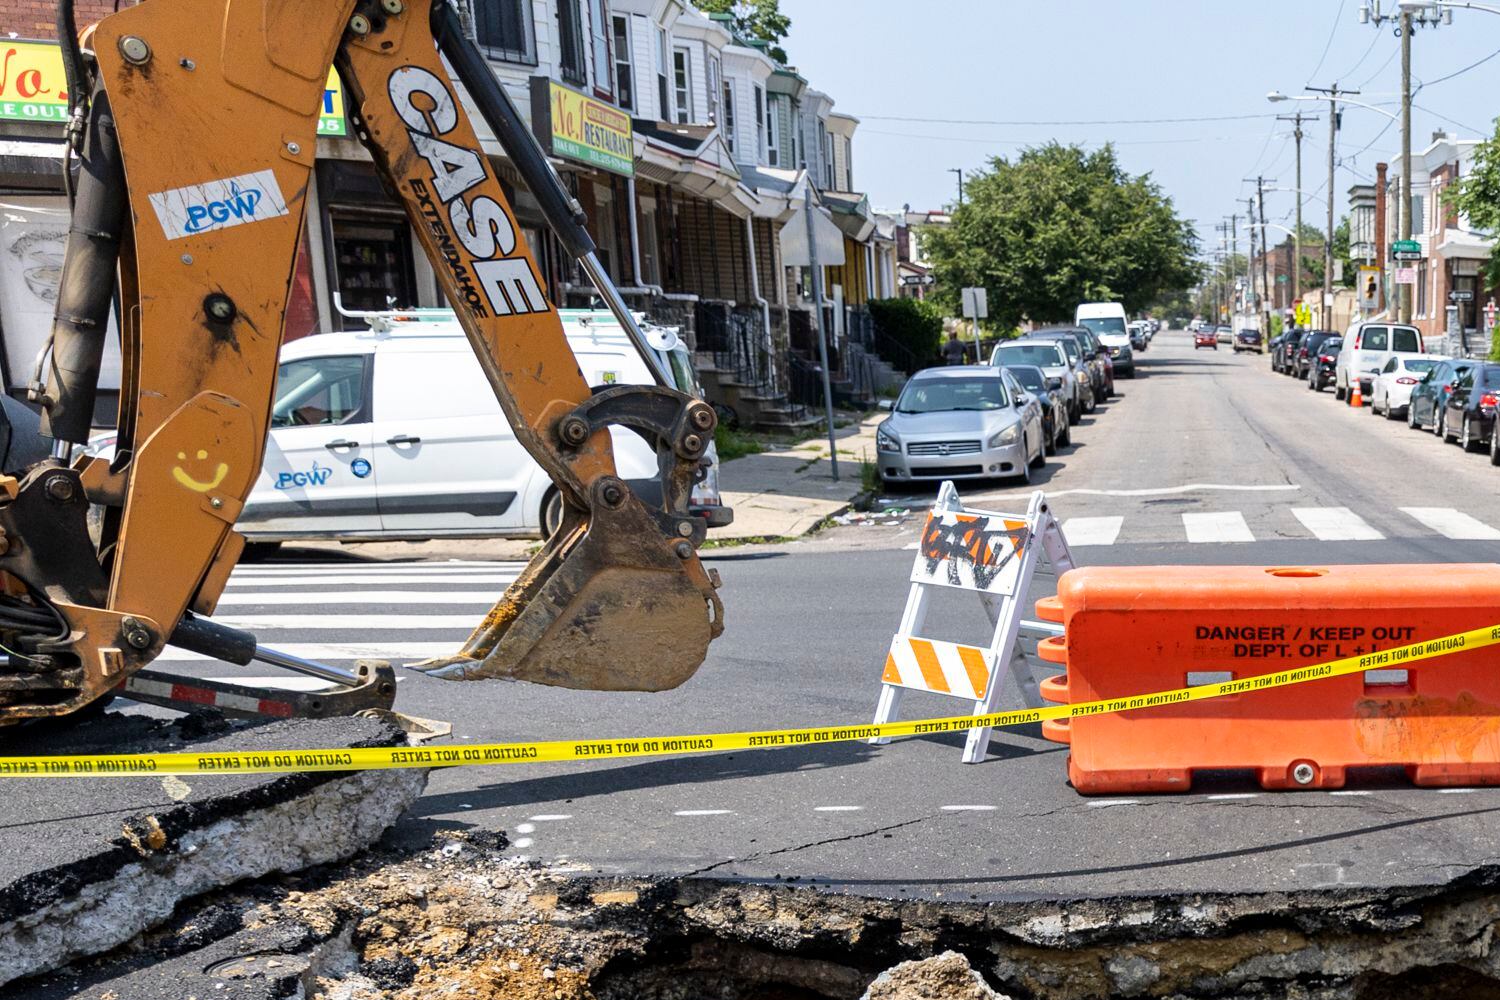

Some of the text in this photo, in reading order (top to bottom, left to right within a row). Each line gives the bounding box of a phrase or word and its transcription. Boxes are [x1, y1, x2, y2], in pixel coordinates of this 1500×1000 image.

[22, 104, 68, 118] OUT
[387, 65, 551, 317] CASE
[186, 192, 256, 229] PGW
[408, 178, 488, 319] EXTENDAHOE
[278, 470, 326, 487] PGW
[1196, 626, 1286, 640] DANGER
[1310, 626, 1366, 640] KEEP
[1372, 626, 1415, 640] OUT
[1234, 644, 1292, 658] DEPT.
[1299, 644, 1331, 658] OF
[1336, 644, 1347, 658] L
